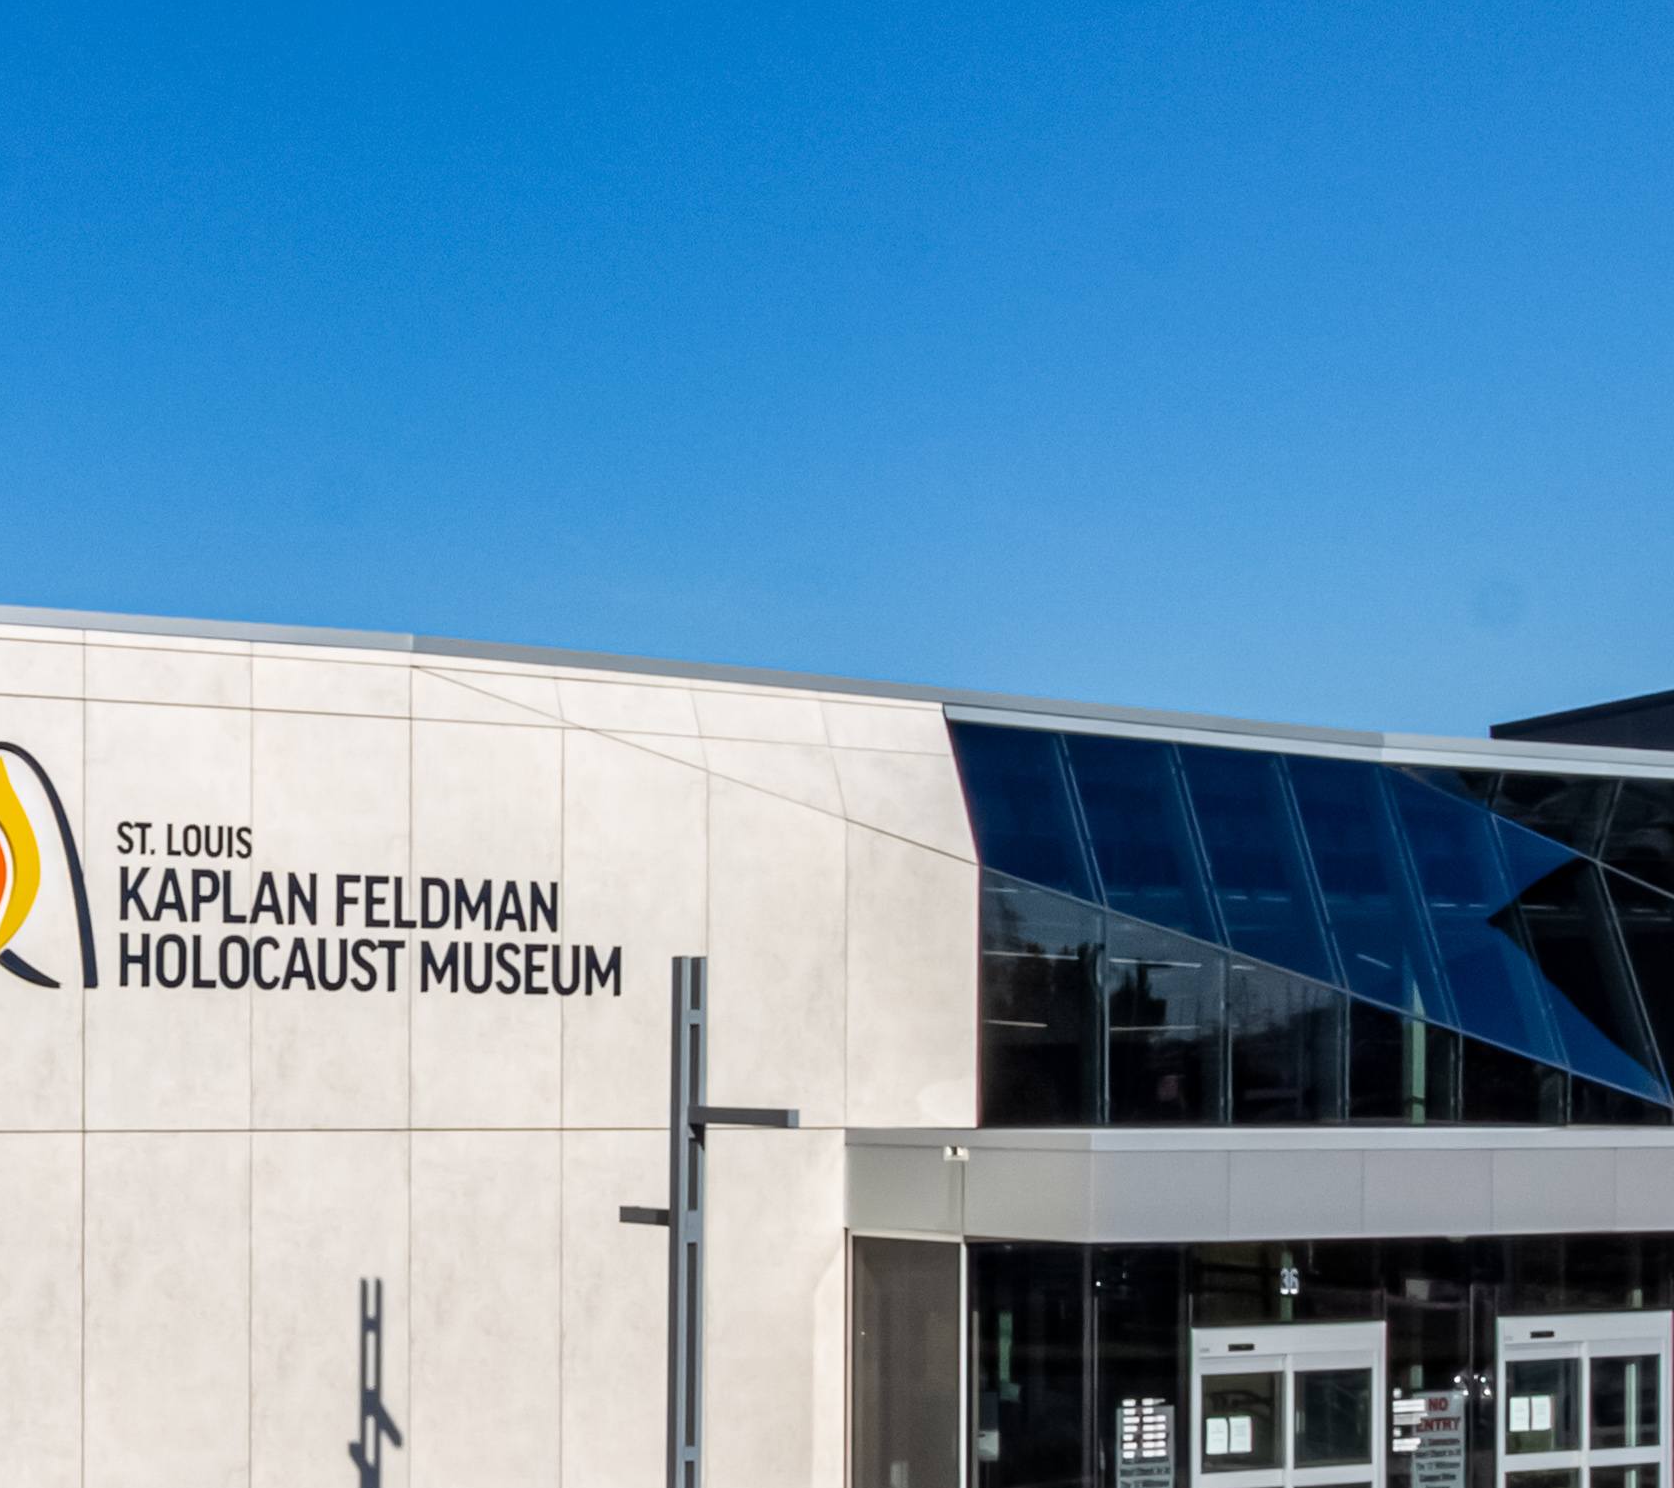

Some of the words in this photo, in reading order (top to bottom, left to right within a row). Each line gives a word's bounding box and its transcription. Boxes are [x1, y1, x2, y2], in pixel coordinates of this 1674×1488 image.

[117, 821, 156, 855] ST.
[166, 823, 253, 858] LOUIS
[119, 866, 318, 926] KAPLAN
[336, 874, 559, 933] FELDMAN
[119, 932, 406, 992] HOLOCAUST
[420, 940, 623, 997] MUSEUM
[1428, 1397, 1448, 1411] NO
